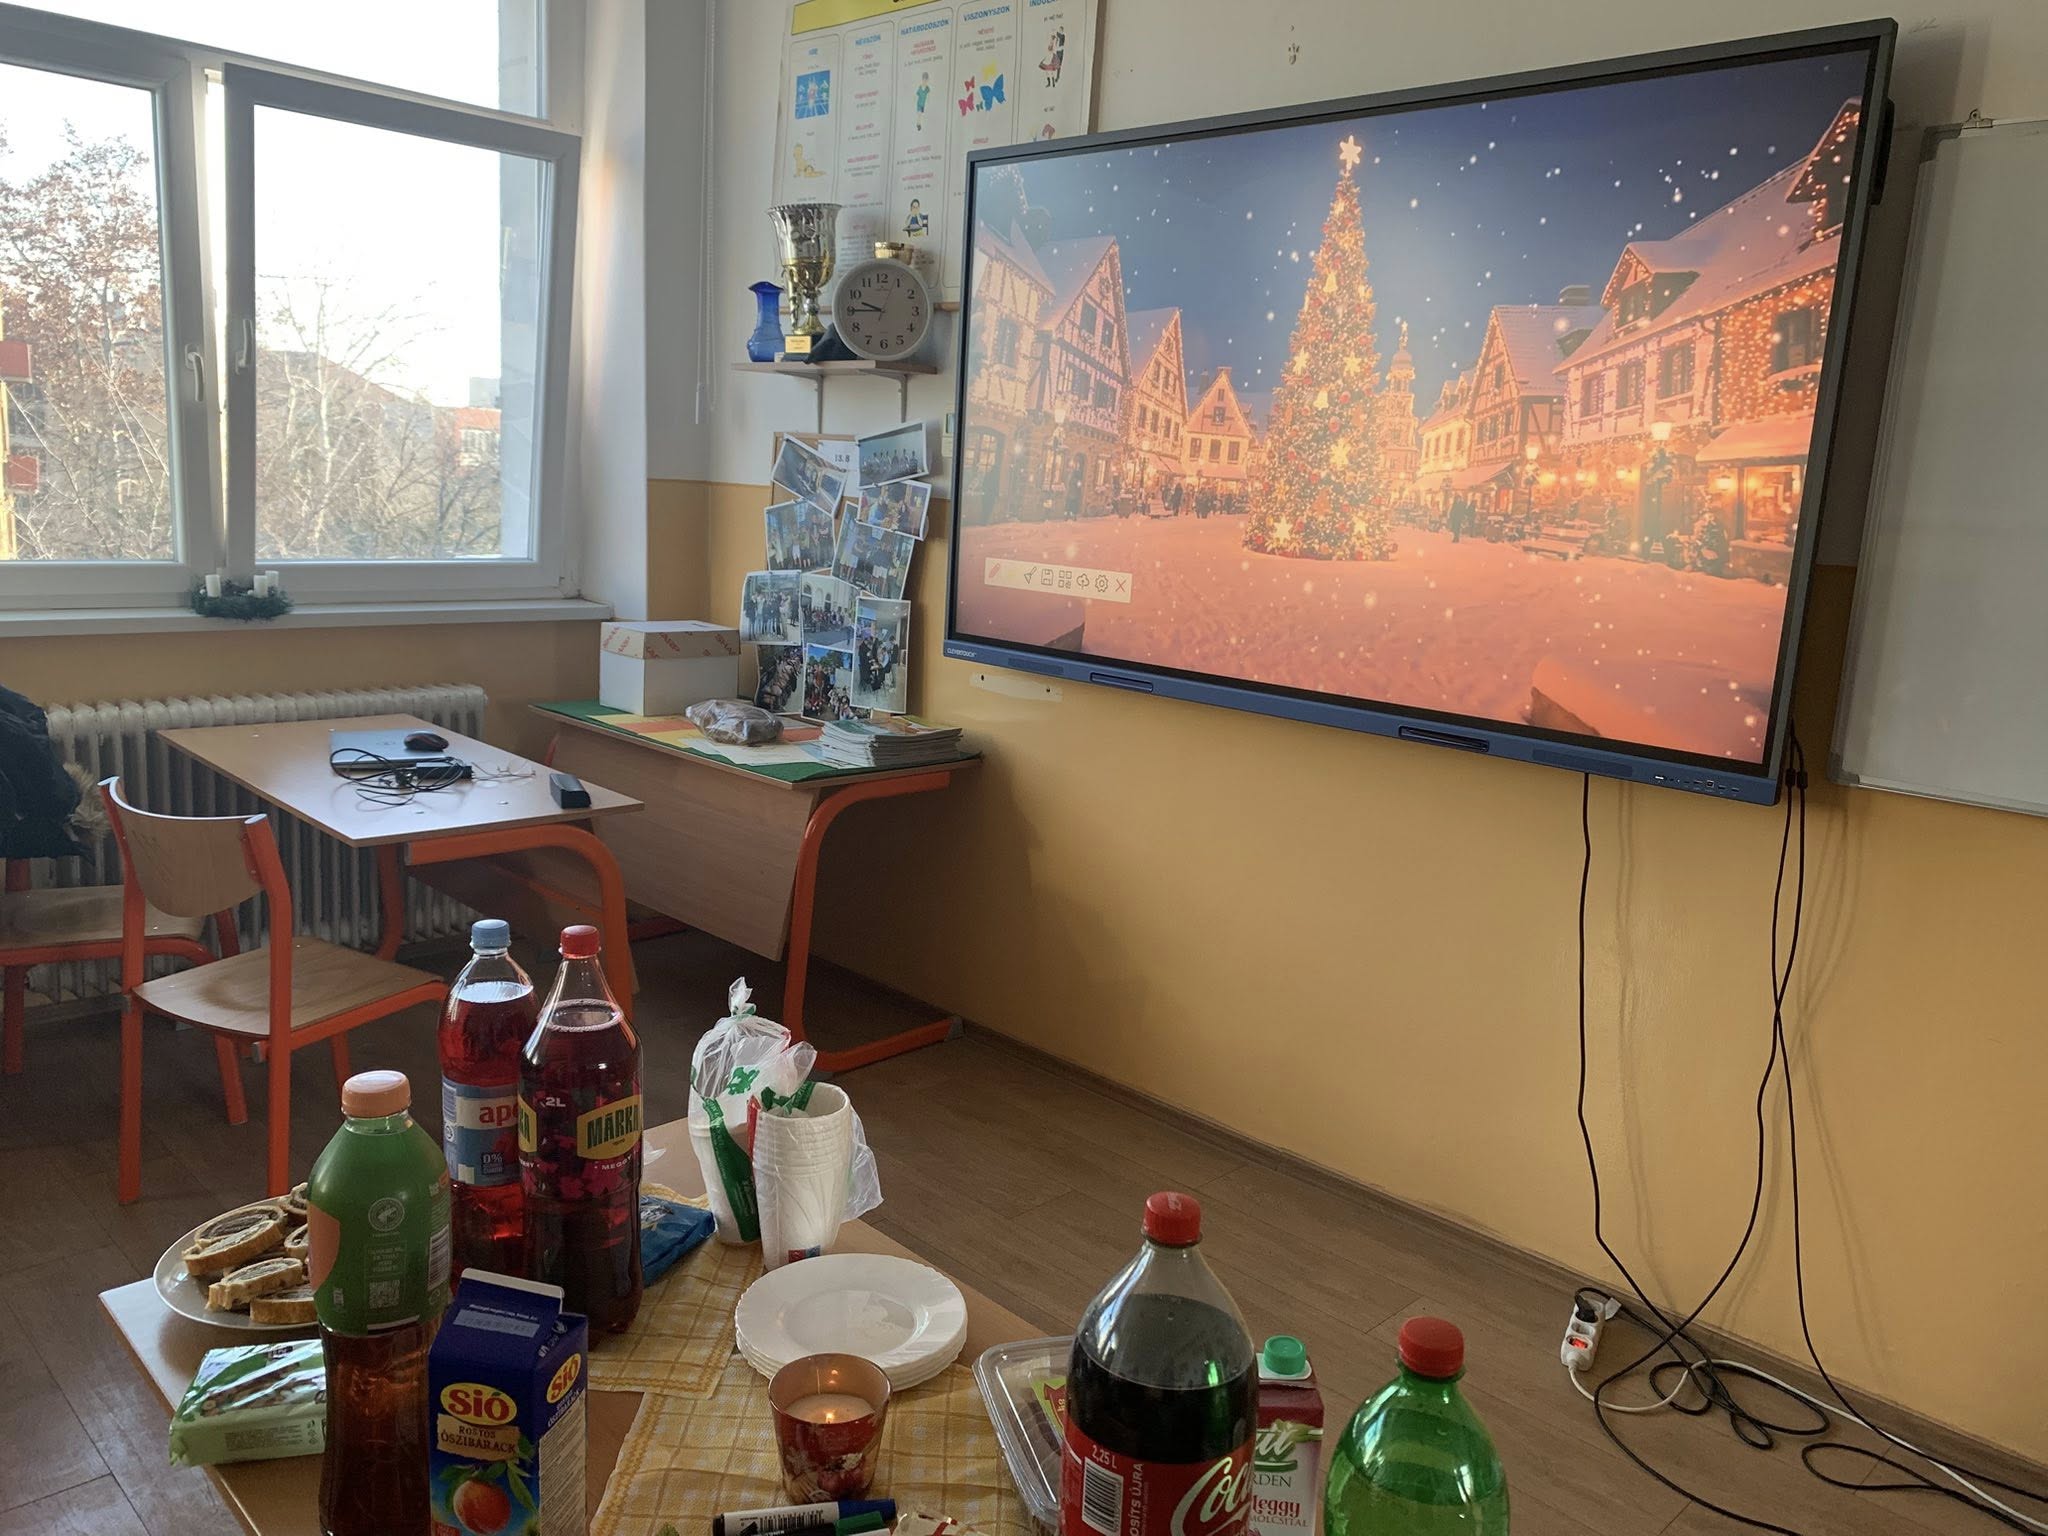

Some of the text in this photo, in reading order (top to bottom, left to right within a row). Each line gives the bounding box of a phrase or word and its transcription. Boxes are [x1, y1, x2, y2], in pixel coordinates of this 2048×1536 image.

[862, 278, 871, 287] 11
[877, 273, 888, 283] 12
[849, 289, 862, 300] 10
[907, 289, 915, 299] 2
[847, 305, 855, 316] 9
[911, 306, 919, 317] 3
[852, 322, 860, 333] 8
[906, 322, 915, 332] 4
[865, 335, 872, 345] 7
[880, 339, 888, 349] 6
[896, 335, 904, 345] 5
[1091, 1444, 1118, 1469] 2,25 L
[1129, 1463, 1144, 1496] ÚJRA
